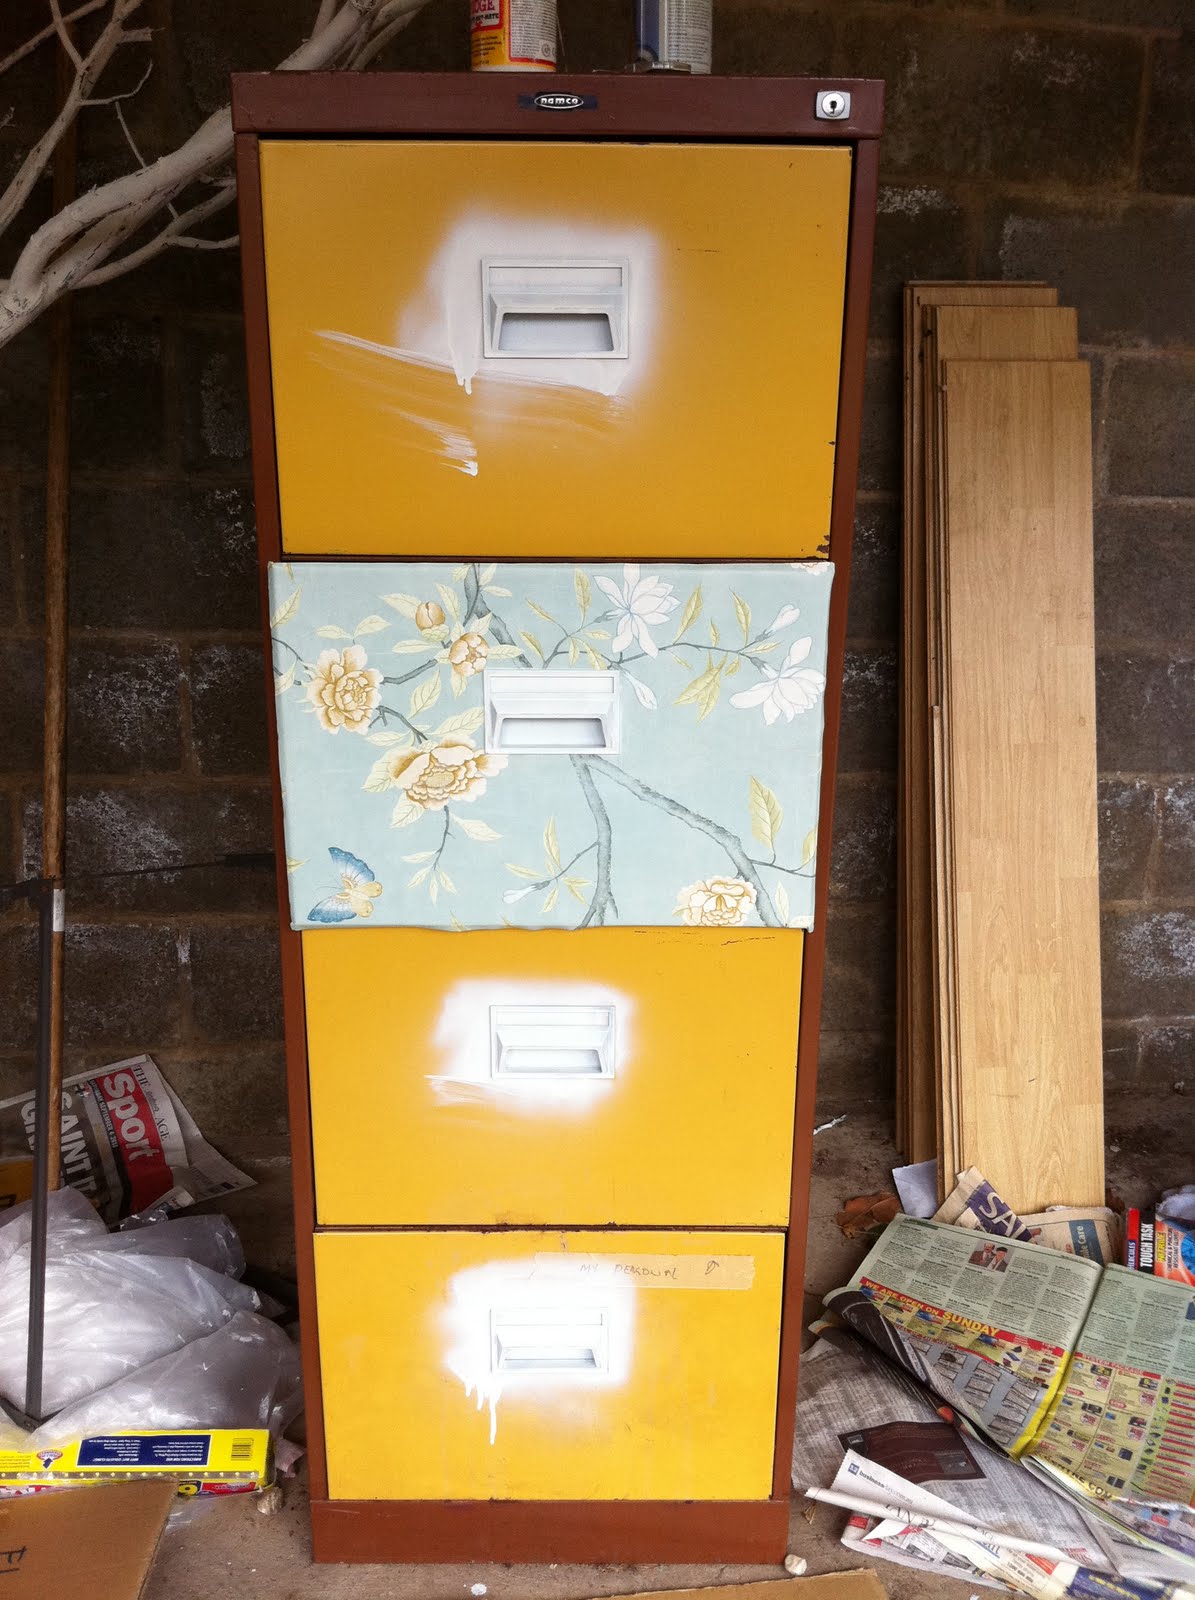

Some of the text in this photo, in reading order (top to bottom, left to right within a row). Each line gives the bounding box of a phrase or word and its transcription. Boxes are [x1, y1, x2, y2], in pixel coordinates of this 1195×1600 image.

[100, 1102, 113, 1131] SEPTEMBER
[104, 1073, 159, 1161] Sport
[134, 1066, 170, 1141] THE AGE
[61, 1091, 91, 1174] SAINT
[1076, 1226, 1086, 1245] Care
[1140, 1223, 1154, 1267] TOUGH TASK
[1157, 1232, 1166, 1262] NITRILE
[580, 1263, 599, 1272] MY
[1127, 1242, 1136, 1270] HERCULES
[866, 1281, 999, 1337] WE ARE OPEN ON SUNDAY
